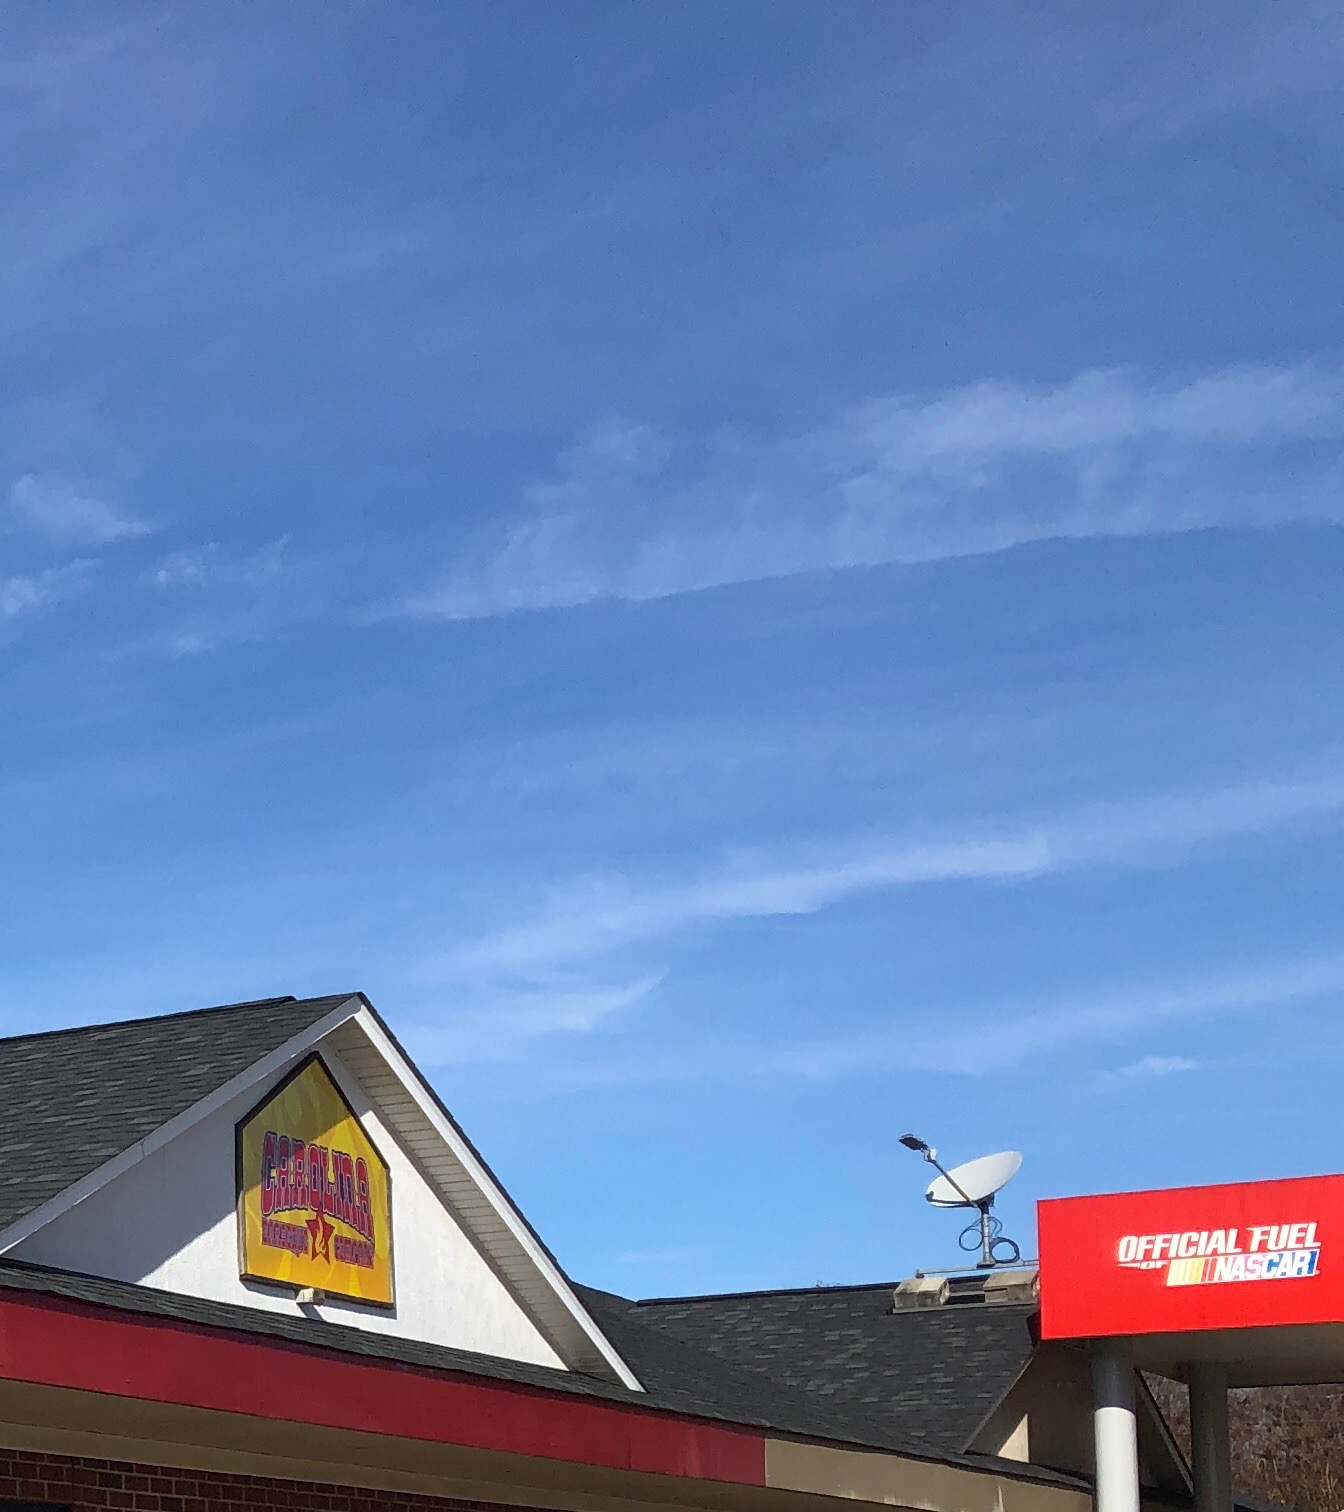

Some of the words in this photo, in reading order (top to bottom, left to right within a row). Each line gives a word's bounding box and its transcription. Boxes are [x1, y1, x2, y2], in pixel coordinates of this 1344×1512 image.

[261, 1131, 375, 1243] CAROLINA
[1118, 1228, 1242, 1262] OFFICIAL
[1246, 1222, 1321, 1252] FUEL
[1213, 1250, 1310, 1281] NASCAR
